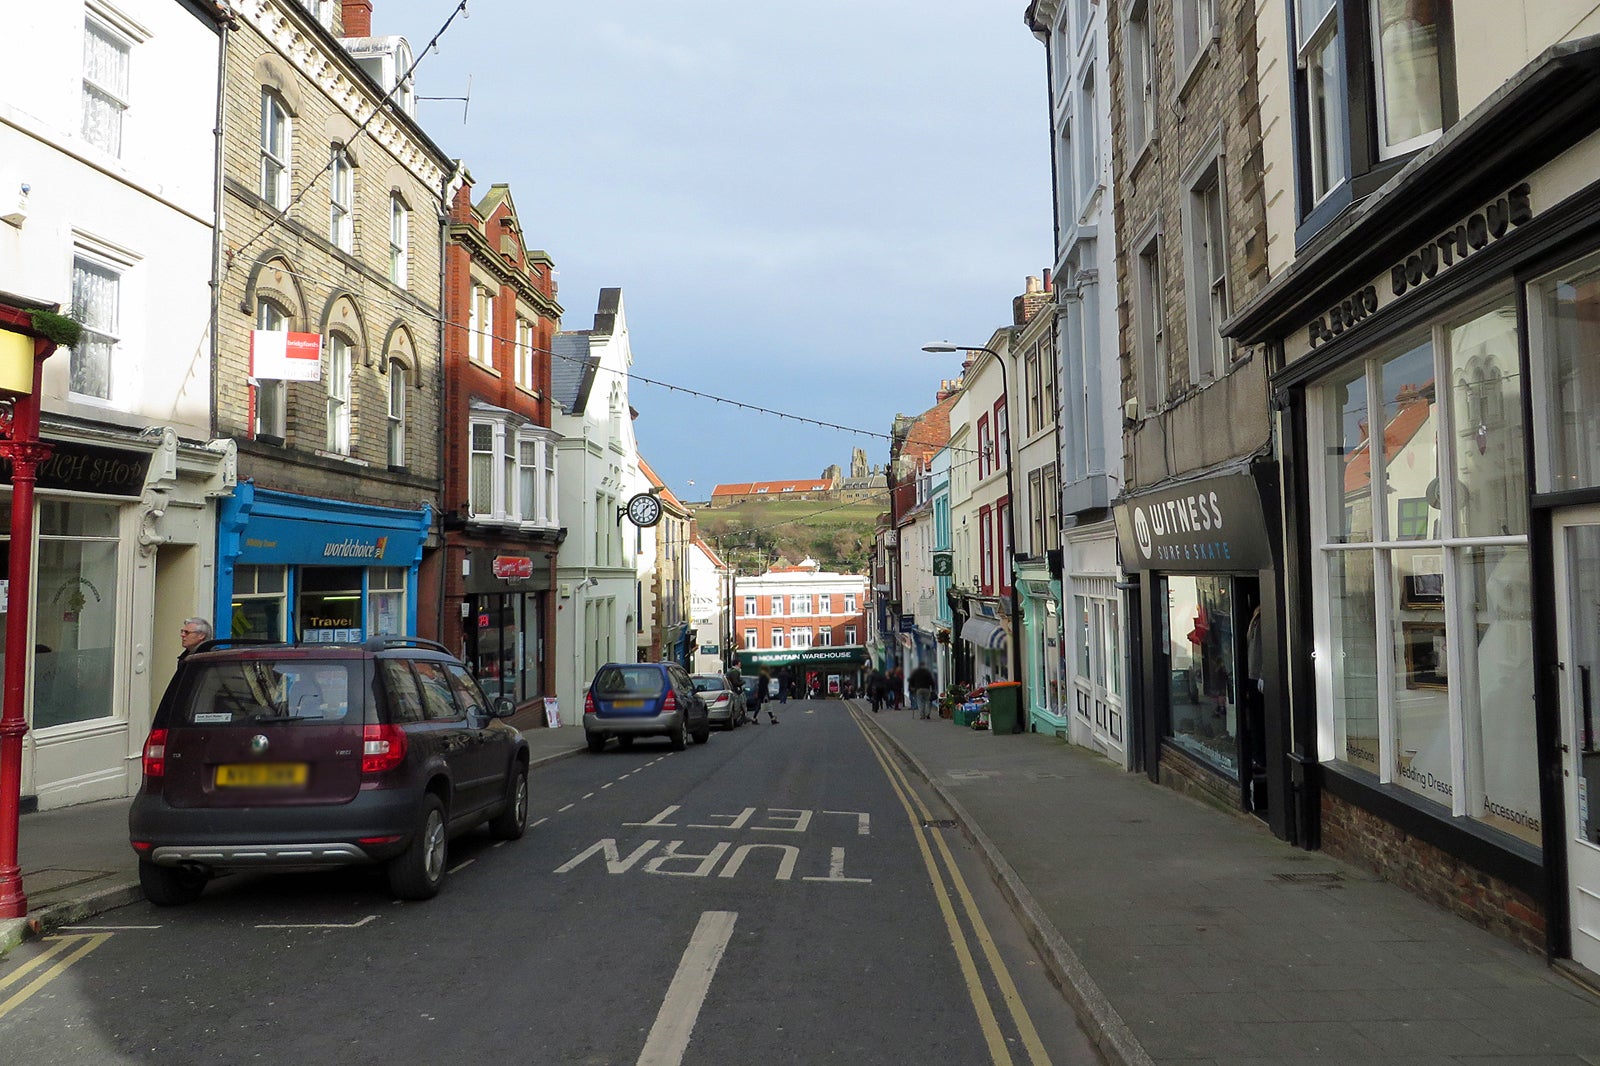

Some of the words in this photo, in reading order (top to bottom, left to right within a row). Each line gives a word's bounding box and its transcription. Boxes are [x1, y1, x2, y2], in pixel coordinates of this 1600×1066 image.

[1392, 182, 1533, 296] BOUTIQUE
[1149, 492, 1222, 536] WITNESS
[324, 538, 375, 557] worldchoice
[1158, 545, 1180, 559] SURF
[1193, 542, 1231, 559] SKATE
[802, 651, 851, 659] WAREHOUSE
[1395, 760, 1426, 789] Wedding
[1428, 772, 1453, 796] Dresse
[622, 805, 870, 835] LEFT
[1483, 795, 1540, 832] Accessories
[553, 838, 872, 883] TURN
